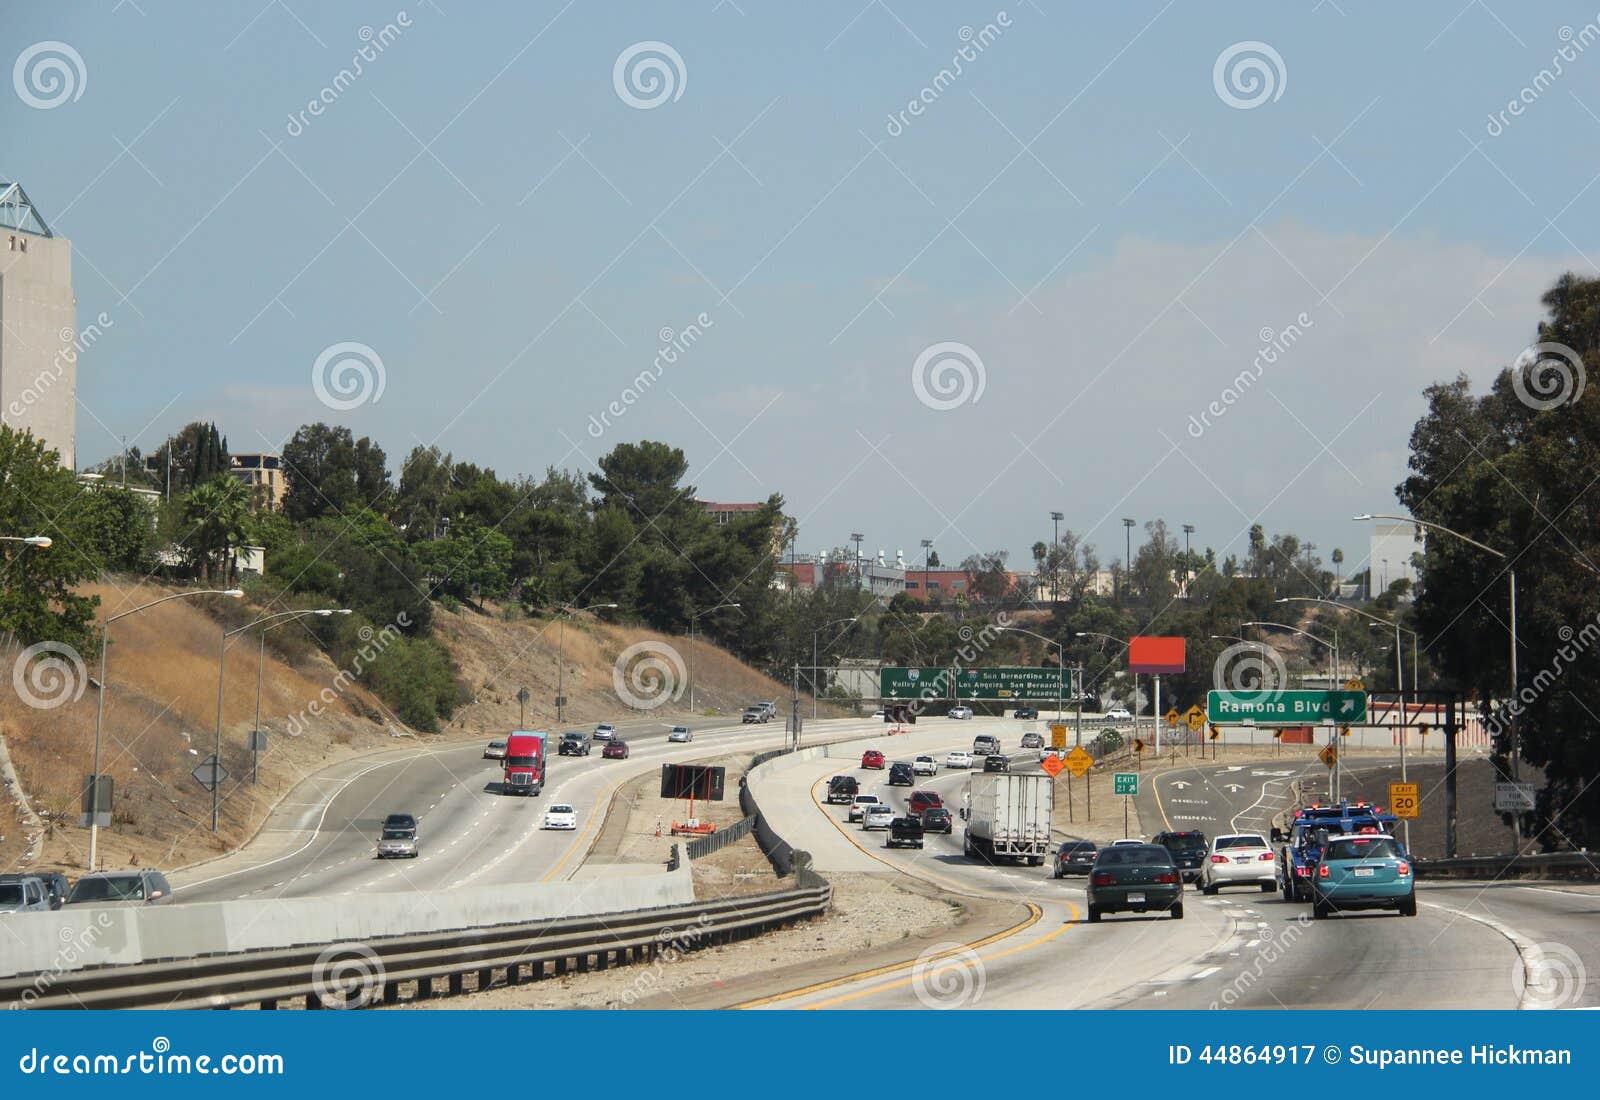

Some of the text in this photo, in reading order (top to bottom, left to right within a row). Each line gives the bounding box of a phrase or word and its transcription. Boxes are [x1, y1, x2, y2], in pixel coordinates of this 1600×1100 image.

[892, 681, 916, 689] Valley
[1219, 700, 1330, 713] Ramona Blvd
[1395, 798, 1413, 808] 20
